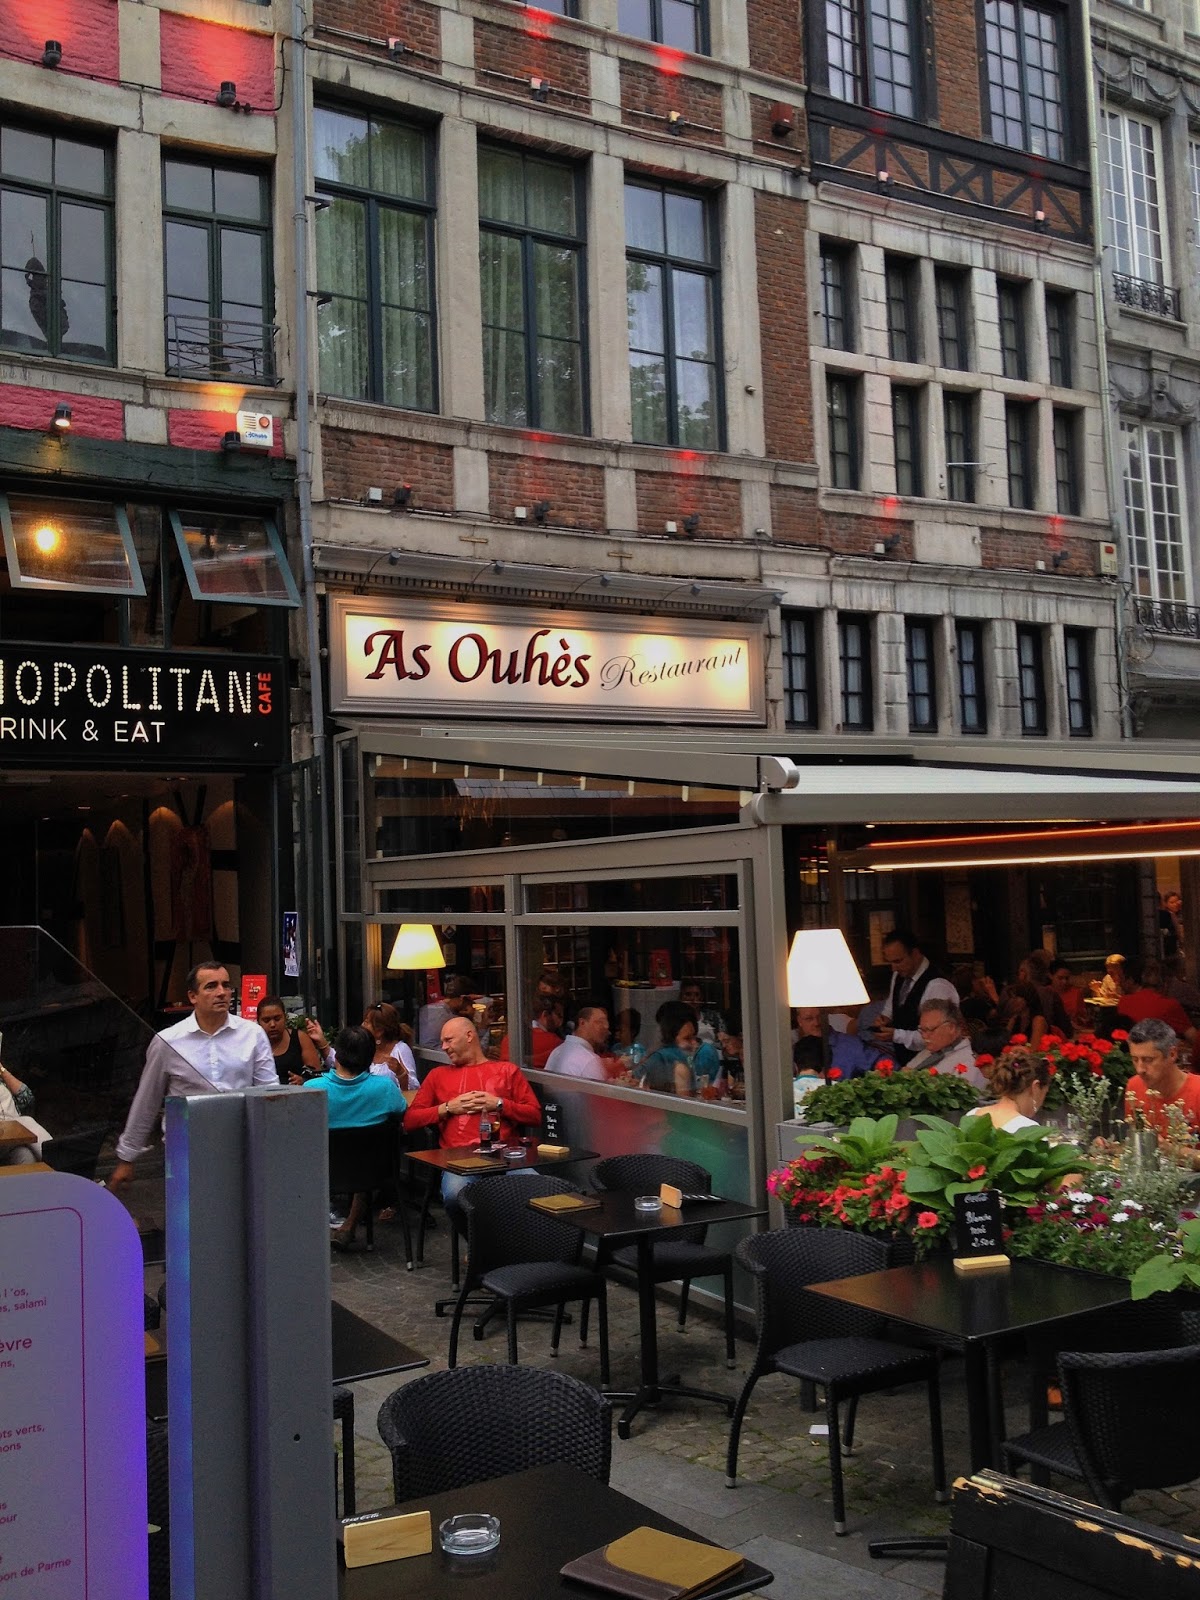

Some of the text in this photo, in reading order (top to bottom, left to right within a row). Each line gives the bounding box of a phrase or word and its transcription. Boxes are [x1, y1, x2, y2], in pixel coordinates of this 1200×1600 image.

[363, 629, 742, 692] As Ouhès Restaurant
[0, 659, 252, 713] OPOLITAN
[258, 672, 272, 714] CAFE
[82, 719, 99, 742] &
[114, 721, 166, 743] EAT
[14, 1296, 47, 1311] salami
[15, 1424, 45, 1436] verts,
[20, 1566, 35, 1578] de
[37, 1558, 72, 1573] Parme
